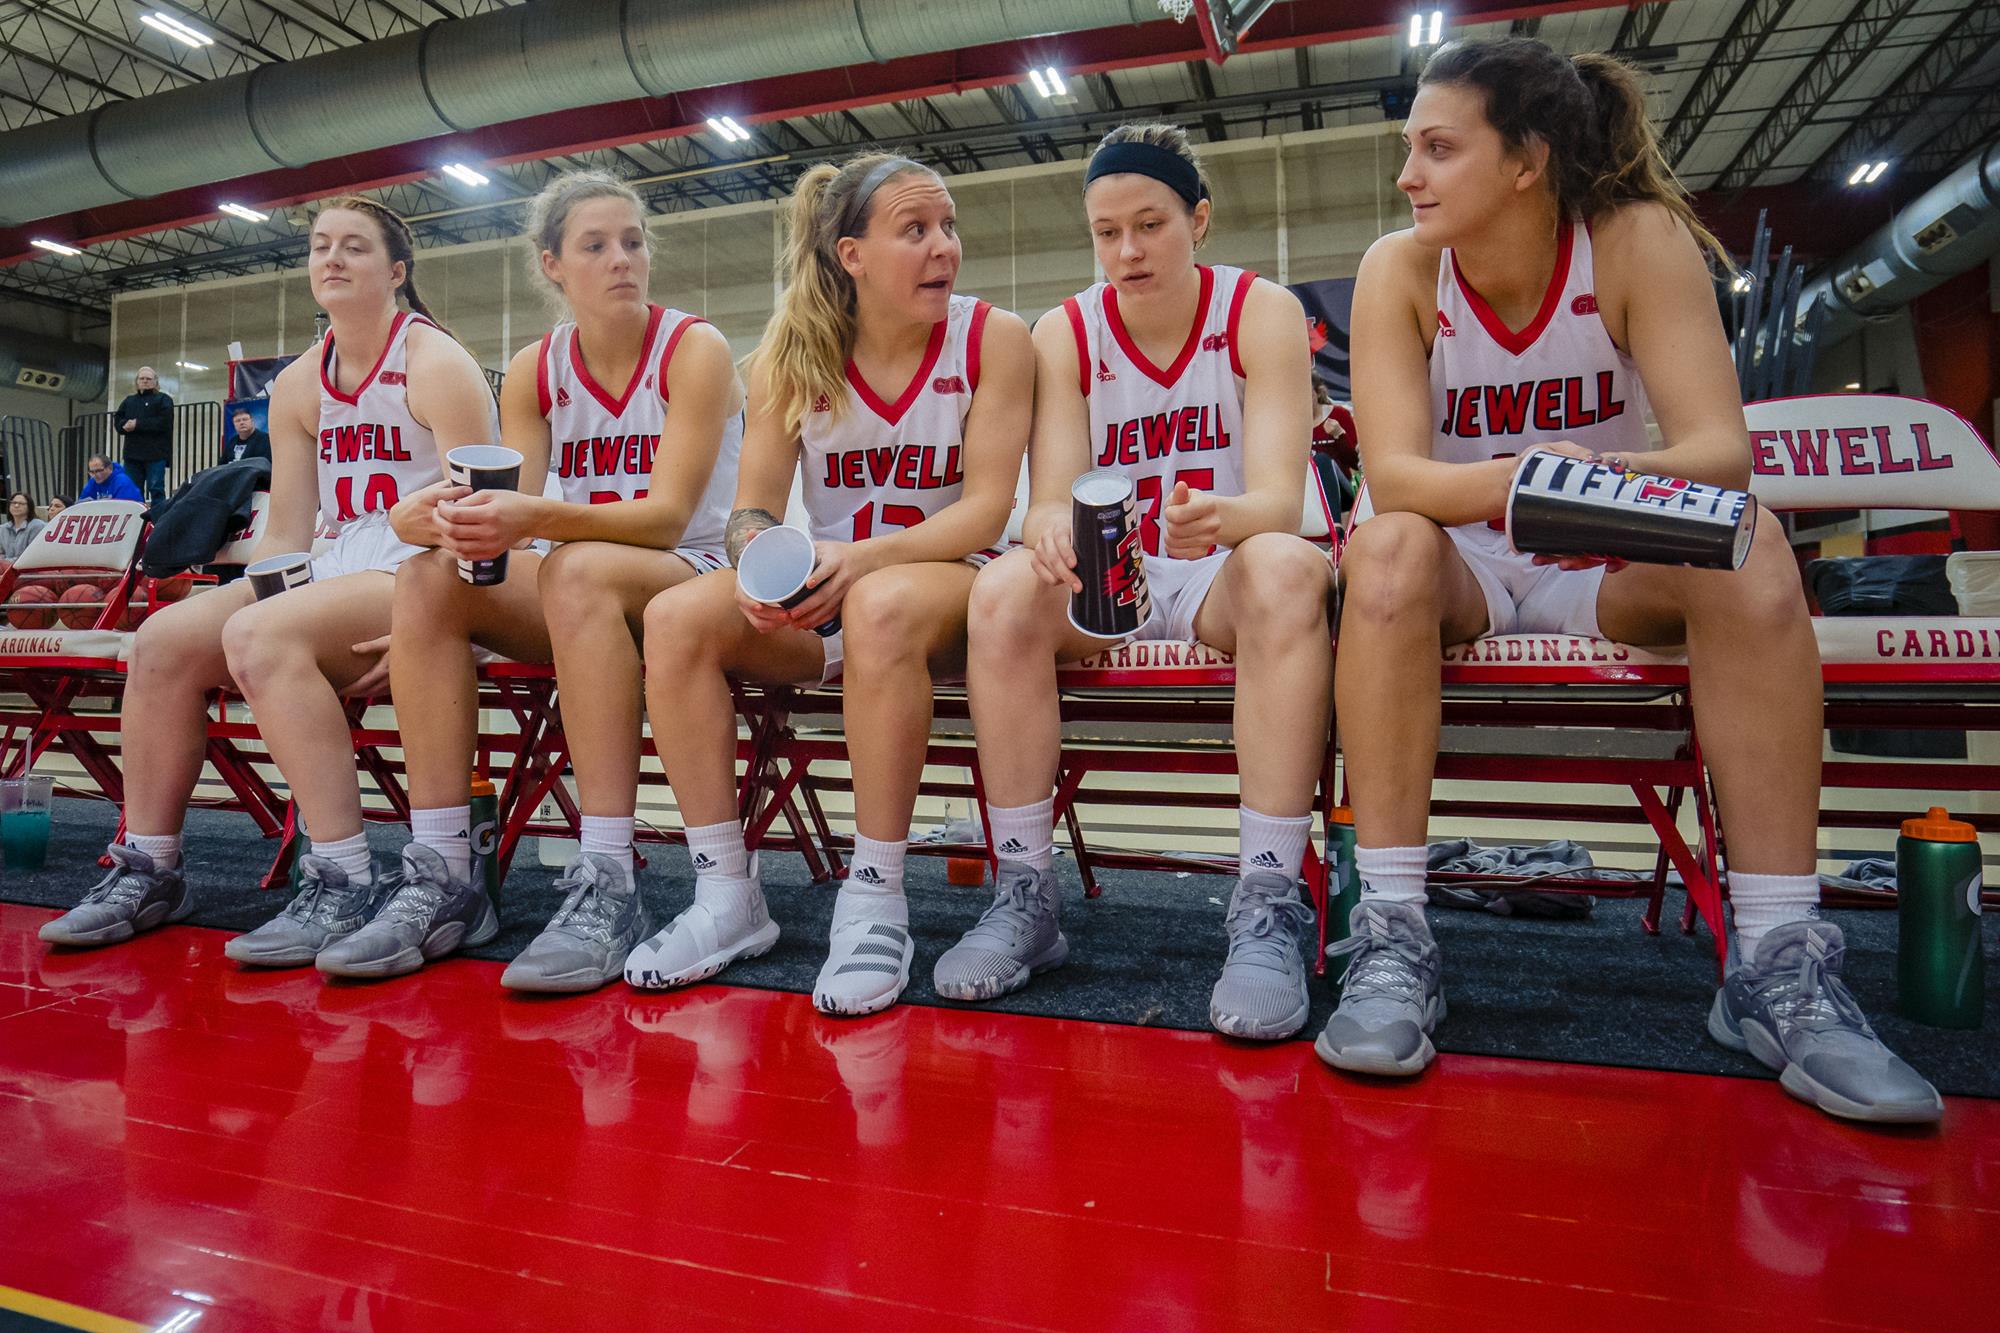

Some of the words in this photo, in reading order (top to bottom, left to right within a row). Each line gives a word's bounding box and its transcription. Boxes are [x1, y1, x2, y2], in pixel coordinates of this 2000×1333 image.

[1440, 370, 1625, 438] JEWELL
[320, 423, 411, 463] EWELL
[1097, 403, 1231, 466] JEWELL
[1750, 423, 1954, 476] EWELL
[823, 444, 964, 489] JEWELL
[44, 513, 132, 545] JEWELL
[0, 637, 63, 653] ARDINALS
[1876, 629, 2000, 658] CARDI
